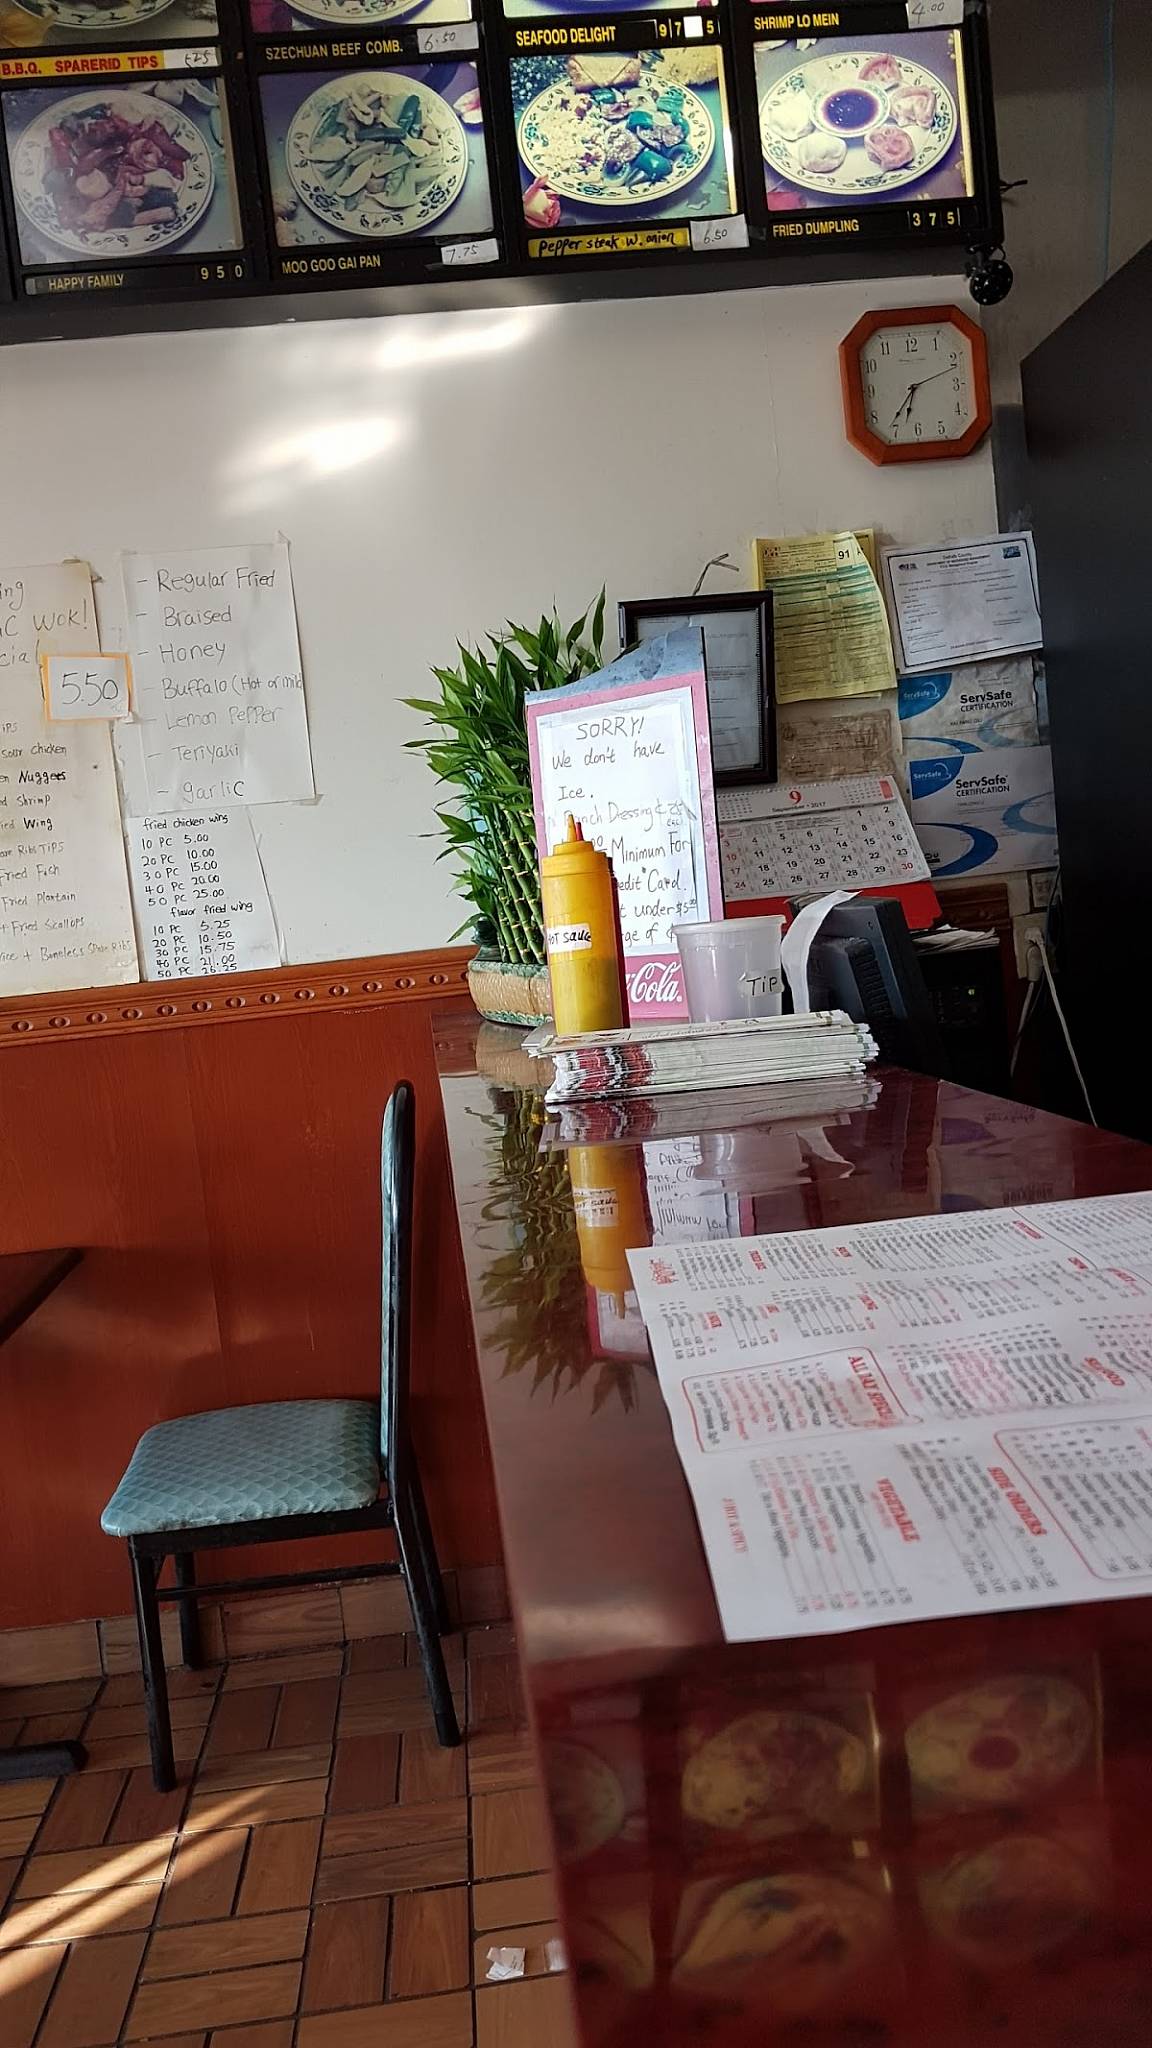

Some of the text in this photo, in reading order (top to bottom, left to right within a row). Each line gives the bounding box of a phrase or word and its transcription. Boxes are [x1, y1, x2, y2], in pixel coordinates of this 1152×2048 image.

[754, 12, 840, 30] SHRIMP LO MEIN
[515, 26, 617, 47] SEAFOOD DELIGHT
[265, 40, 403, 61] SZECHUAN BEEF COMB.
[1, 55, 159, 77] B.B.Q. SPARERID TIPS
[772, 219, 860, 238] FRIED DUMPLING
[646, 231, 676, 246] onion
[281, 254, 381, 275] MOO GOO GAI PAN
[48, 273, 124, 291] HAPPY FAMILY
[880, 341, 890, 356] 11
[905, 337, 918, 353] 12
[932, 337, 938, 351] 1
[865, 359, 877, 374] 10
[867, 384, 875, 399] 9
[953, 377, 960, 392] 3
[954, 402, 961, 416] 4
[870, 410, 878, 425] 8
[892, 424, 900, 439] 7
[914, 423, 922, 437] 6
[937, 421, 945, 435] 5
[838, 549, 850, 560] 91
[156, 566, 276, 593] Regular Fried
[163, 604, 233, 627] Braised
[159, 641, 227, 665] Honey
[161, 676, 229, 700] Buffalo
[960, 689, 1013, 704] ServSafe
[960, 700, 1014, 713] CERTIFICATION
[575, 716, 645, 741] SORRY!
[552, 740, 666, 771] We don't have
[955, 774, 1008, 789] ServSafe
[789, 790, 802, 805] 9
[956, 785, 1010, 798] CERTIFICATION
[23, 817, 54, 832] Wing
[143, 812, 229, 831] fried chicken wing
[141, 833, 209, 851] 10 PC 5.00
[611, 835, 667, 865] Minimum
[668, 831, 692, 856] For
[141, 848, 215, 868] 20 PC 10.00
[781, 847, 792, 855] 12
[730, 867, 741, 875] 17
[758, 864, 770, 872] 18
[897, 848, 908, 856] 23
[166, 867, 180, 879] PC
[190, 860, 218, 873] 15.00
[145, 873, 220, 895] 40 PC 20.00
[735, 881, 746, 889] 24
[763, 878, 774, 886] 25
[790, 875, 803, 883] 26
[846, 869, 858, 877] 28
[174, 894, 187, 905] PC
[193, 888, 225, 900] 25.00
[202, 903, 227, 915] fried
[230, 900, 254, 913] wing
[634, 898, 676, 918] under
[153, 925, 164, 936] 10
[169, 923, 181, 935] PC
[152, 938, 167, 949] 20
[173, 935, 187, 946] PC
[155, 948, 169, 958] 30
[174, 946, 188, 956] PC
[156, 958, 170, 969] 40
[174, 956, 190, 966] PC
[157, 969, 172, 979] 50
[178, 966, 193, 977] PC
